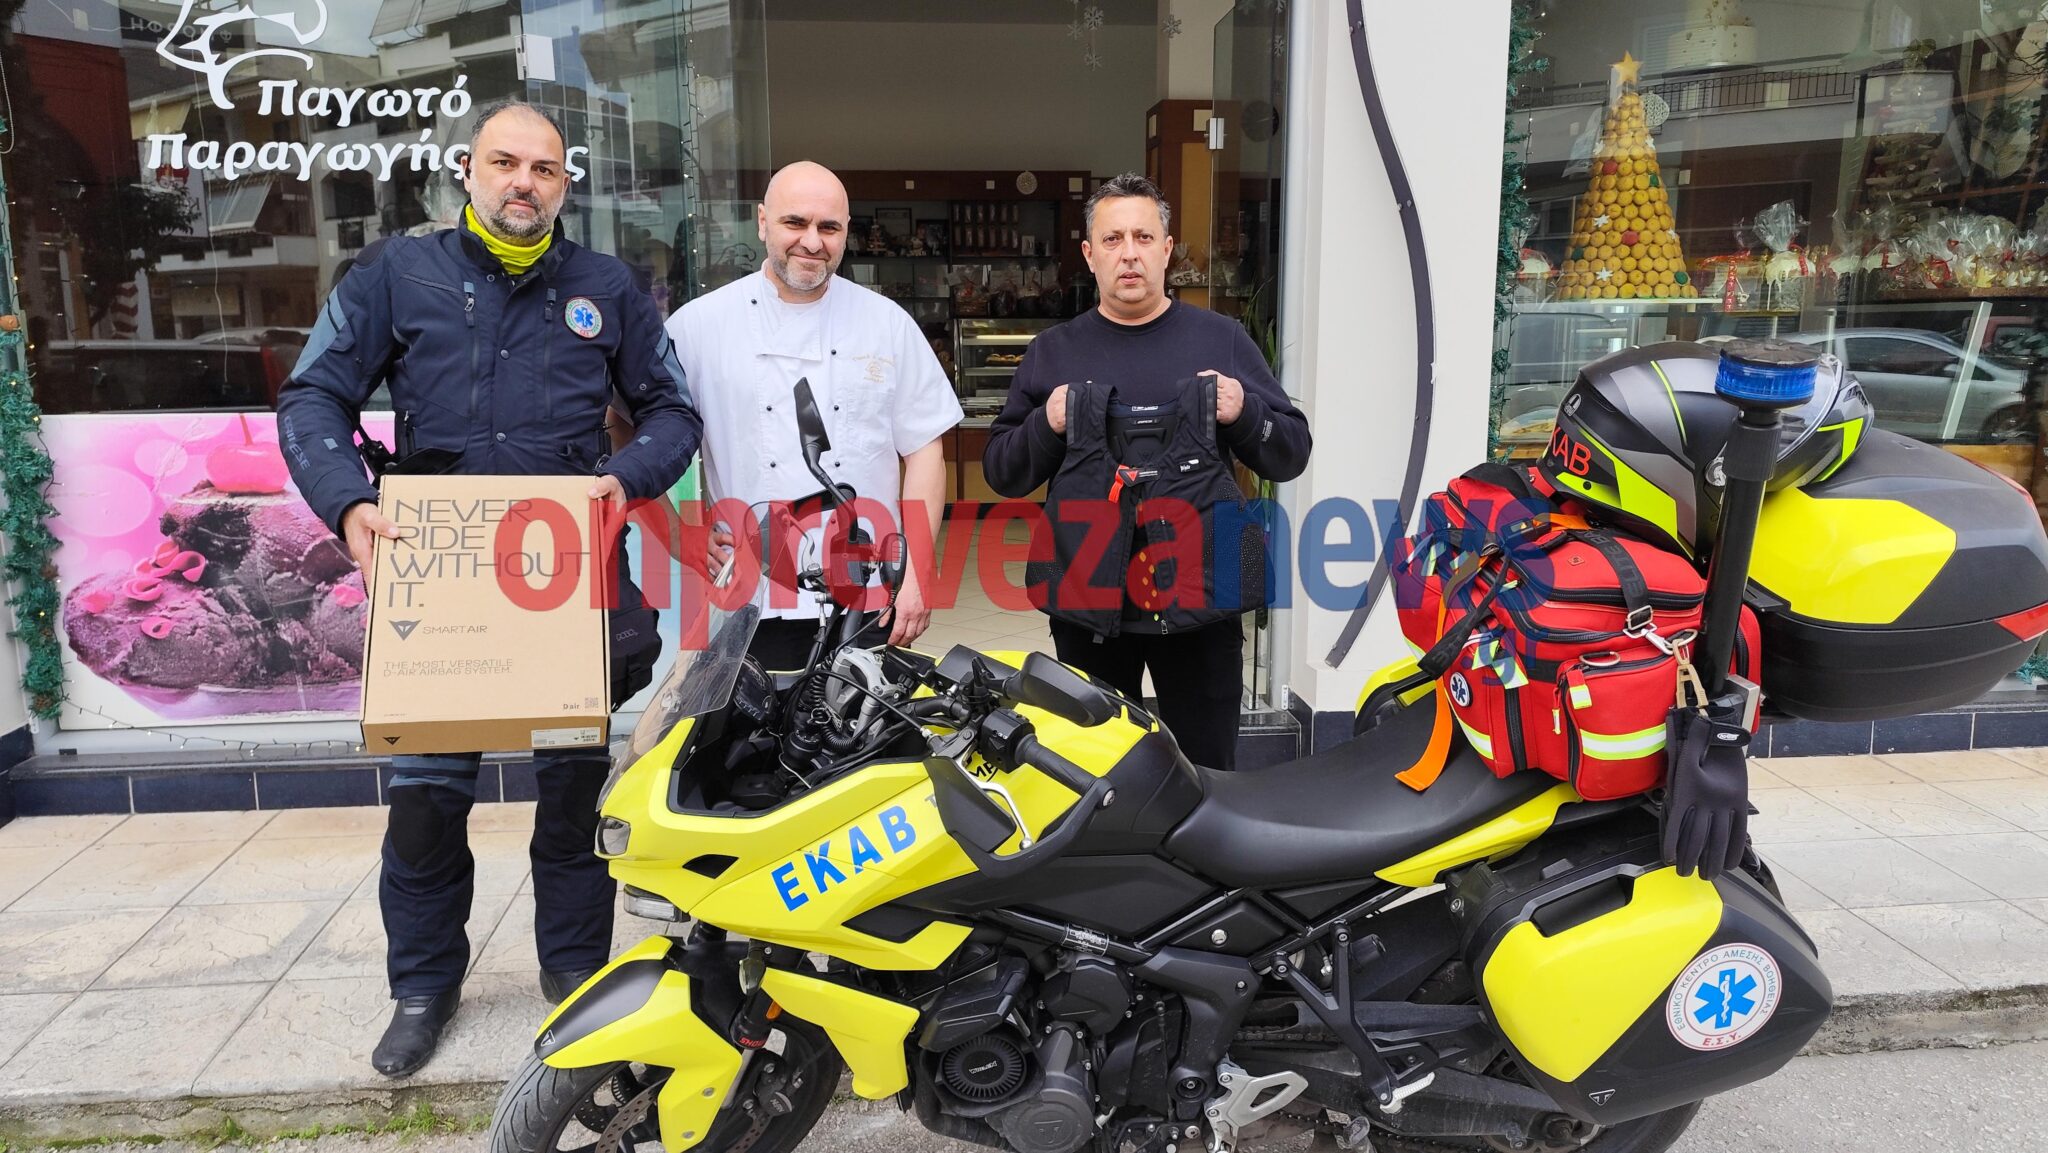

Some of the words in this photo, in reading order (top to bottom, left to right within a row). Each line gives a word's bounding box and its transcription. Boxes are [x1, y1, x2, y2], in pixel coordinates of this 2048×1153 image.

[257, 74, 472, 127] Παγωτό
[147, 128, 471, 181] Παραγωγής
[394, 499, 533, 523] NEVER
[392, 525, 486, 551] RIDE
[389, 551, 591, 579] WITHOUT
[388, 581, 425, 608] IT.
[383, 668, 416, 678] D-AIR
[419, 667, 461, 676] AIRBAG
[384, 661, 408, 670] THE
[412, 660, 447, 669] MOST
[449, 658, 513, 668] VERSATILE
[1672, 992, 1686, 1031] ΕΘΝΙΚΟ
[1680, 954, 1719, 989] ΚΕΝΤΡΟ
